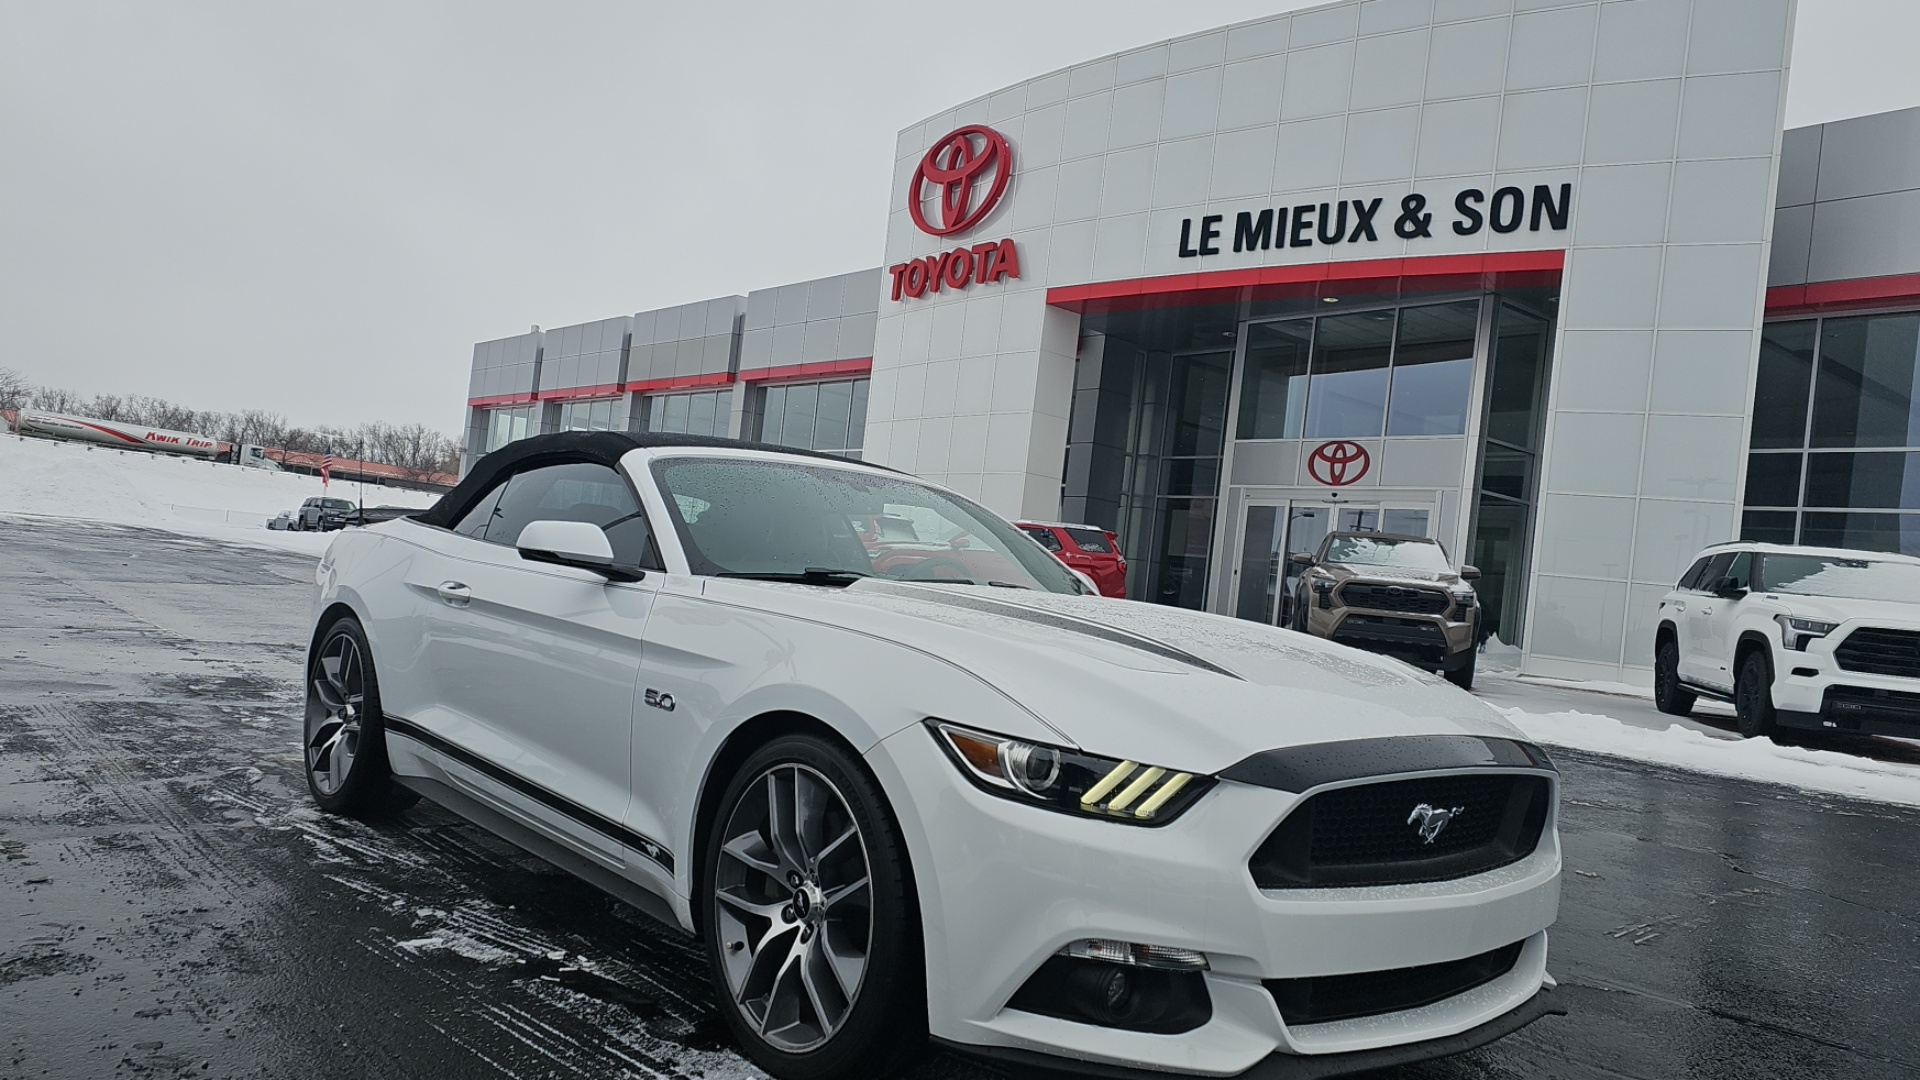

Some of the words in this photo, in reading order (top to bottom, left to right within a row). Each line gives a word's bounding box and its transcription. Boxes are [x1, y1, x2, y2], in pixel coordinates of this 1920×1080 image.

[1178, 214, 1222, 258] LE
[1233, 198, 1383, 253] MIEUX
[1394, 193, 1432, 239] &
[1452, 183, 1572, 236] SON
[889, 238, 1020, 301] TOYOTA
[145, 431, 180, 444] KWIK
[186, 437, 213, 448] TRIP
